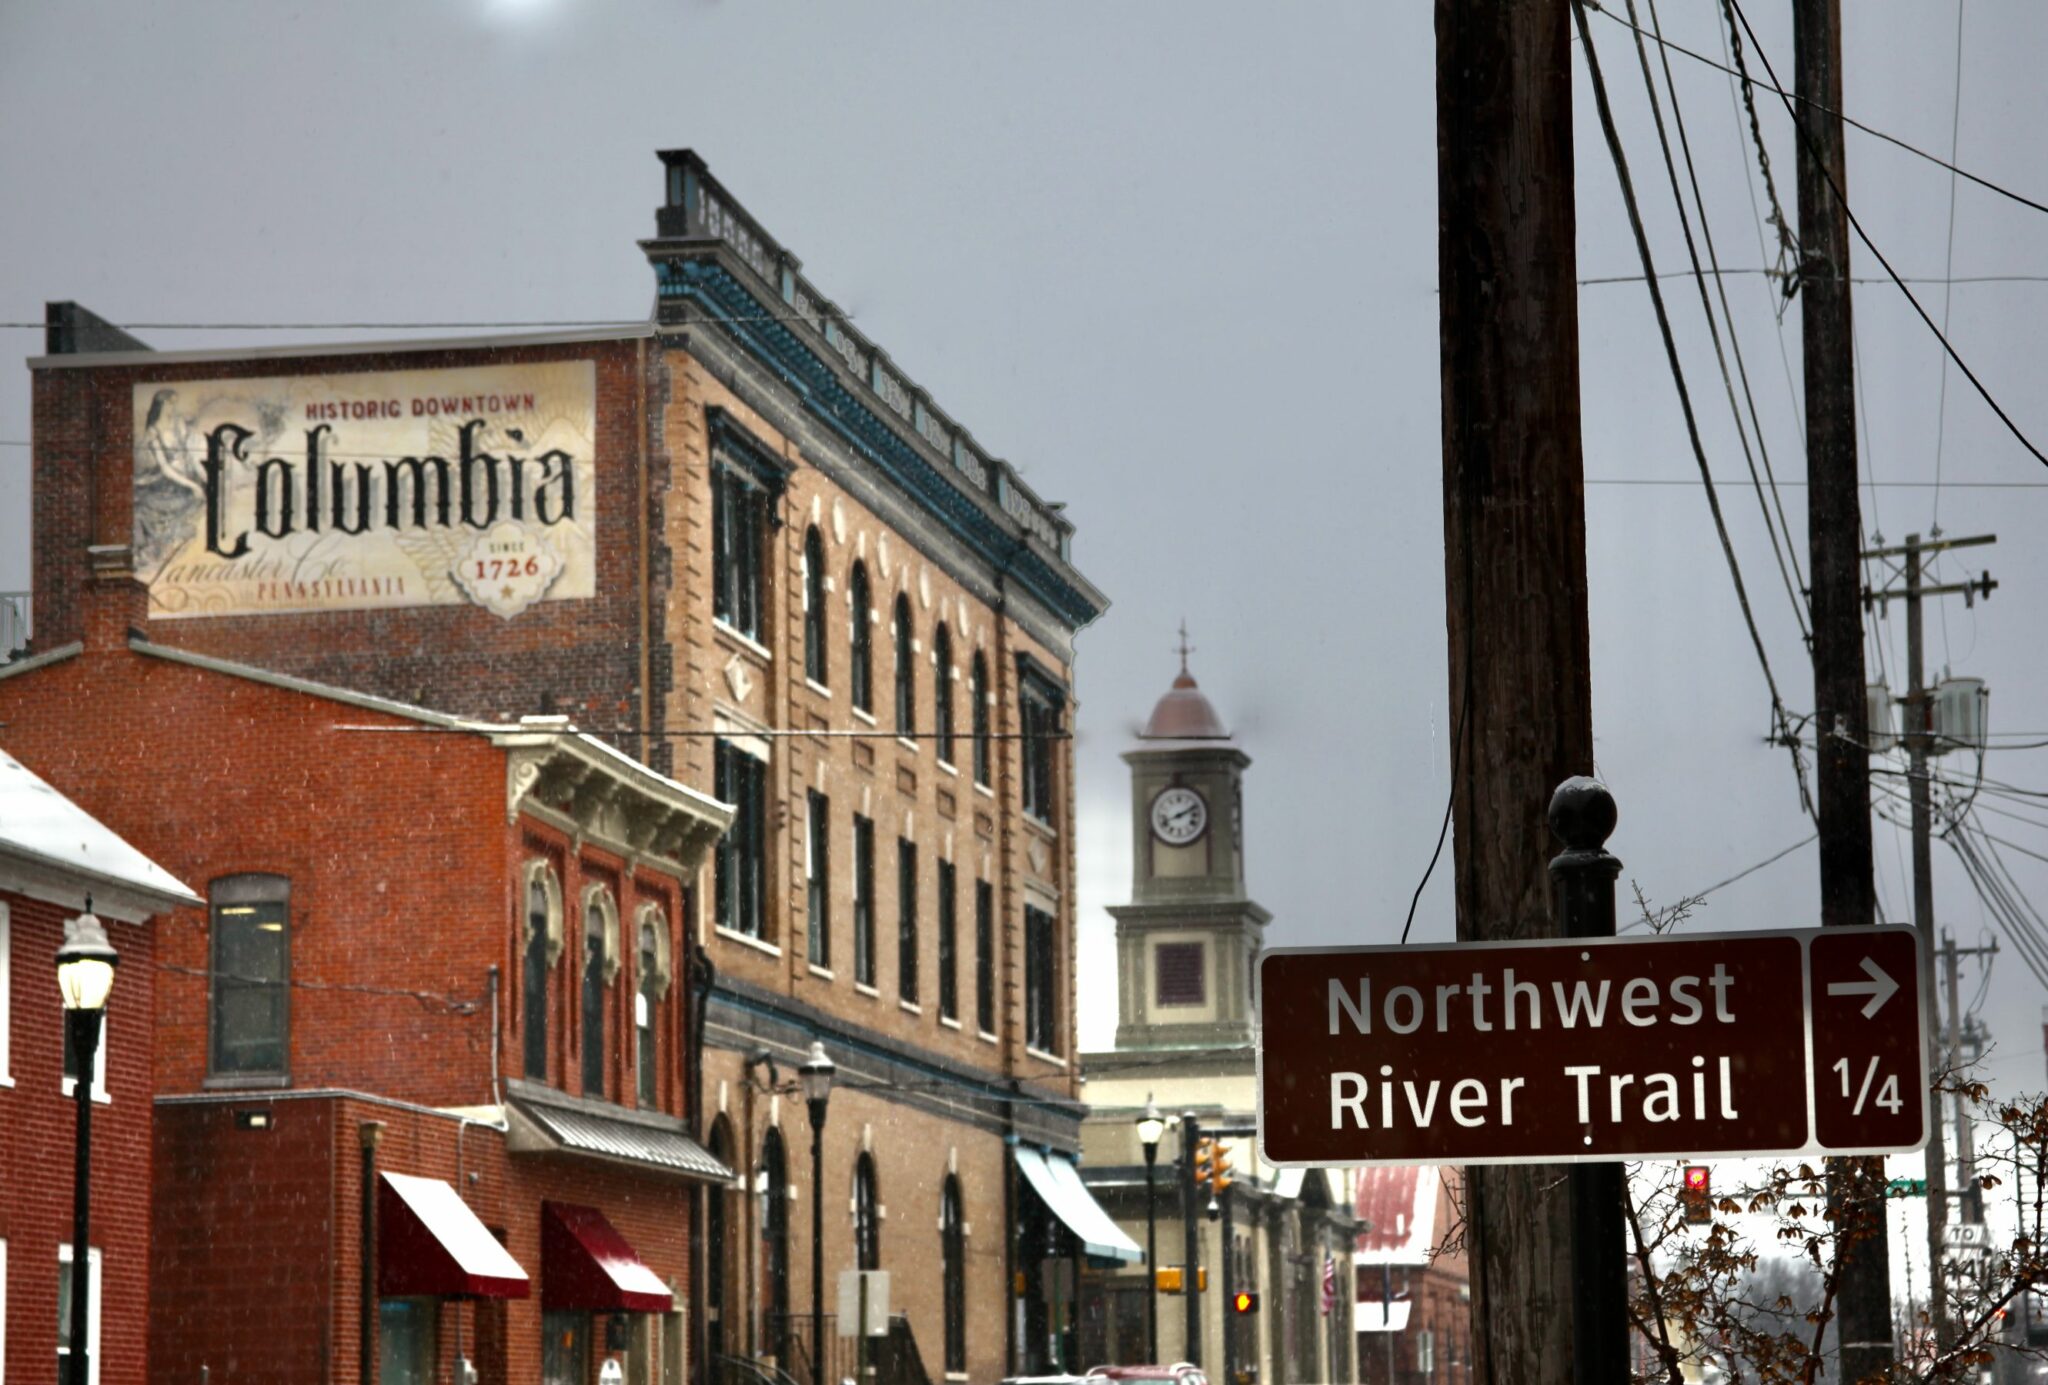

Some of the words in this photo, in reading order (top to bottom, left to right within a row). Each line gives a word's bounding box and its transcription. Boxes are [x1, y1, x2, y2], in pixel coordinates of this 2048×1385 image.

[306, 400, 402, 420] HISTORIC
[412, 394, 535, 416] DOWNTOWN
[203, 418, 576, 559] Columbia
[489, 542, 525, 553] SINCE
[476, 555, 539, 580] 1726
[257, 576, 405, 601] PENNSYLVANIA
[1328, 963, 1736, 1035] Northwest
[1330, 1065, 1525, 1130] River
[1563, 1056, 1739, 1124] Trail
[1832, 1055, 1904, 1115] 1/4
[1951, 1227, 1974, 1241] TO
